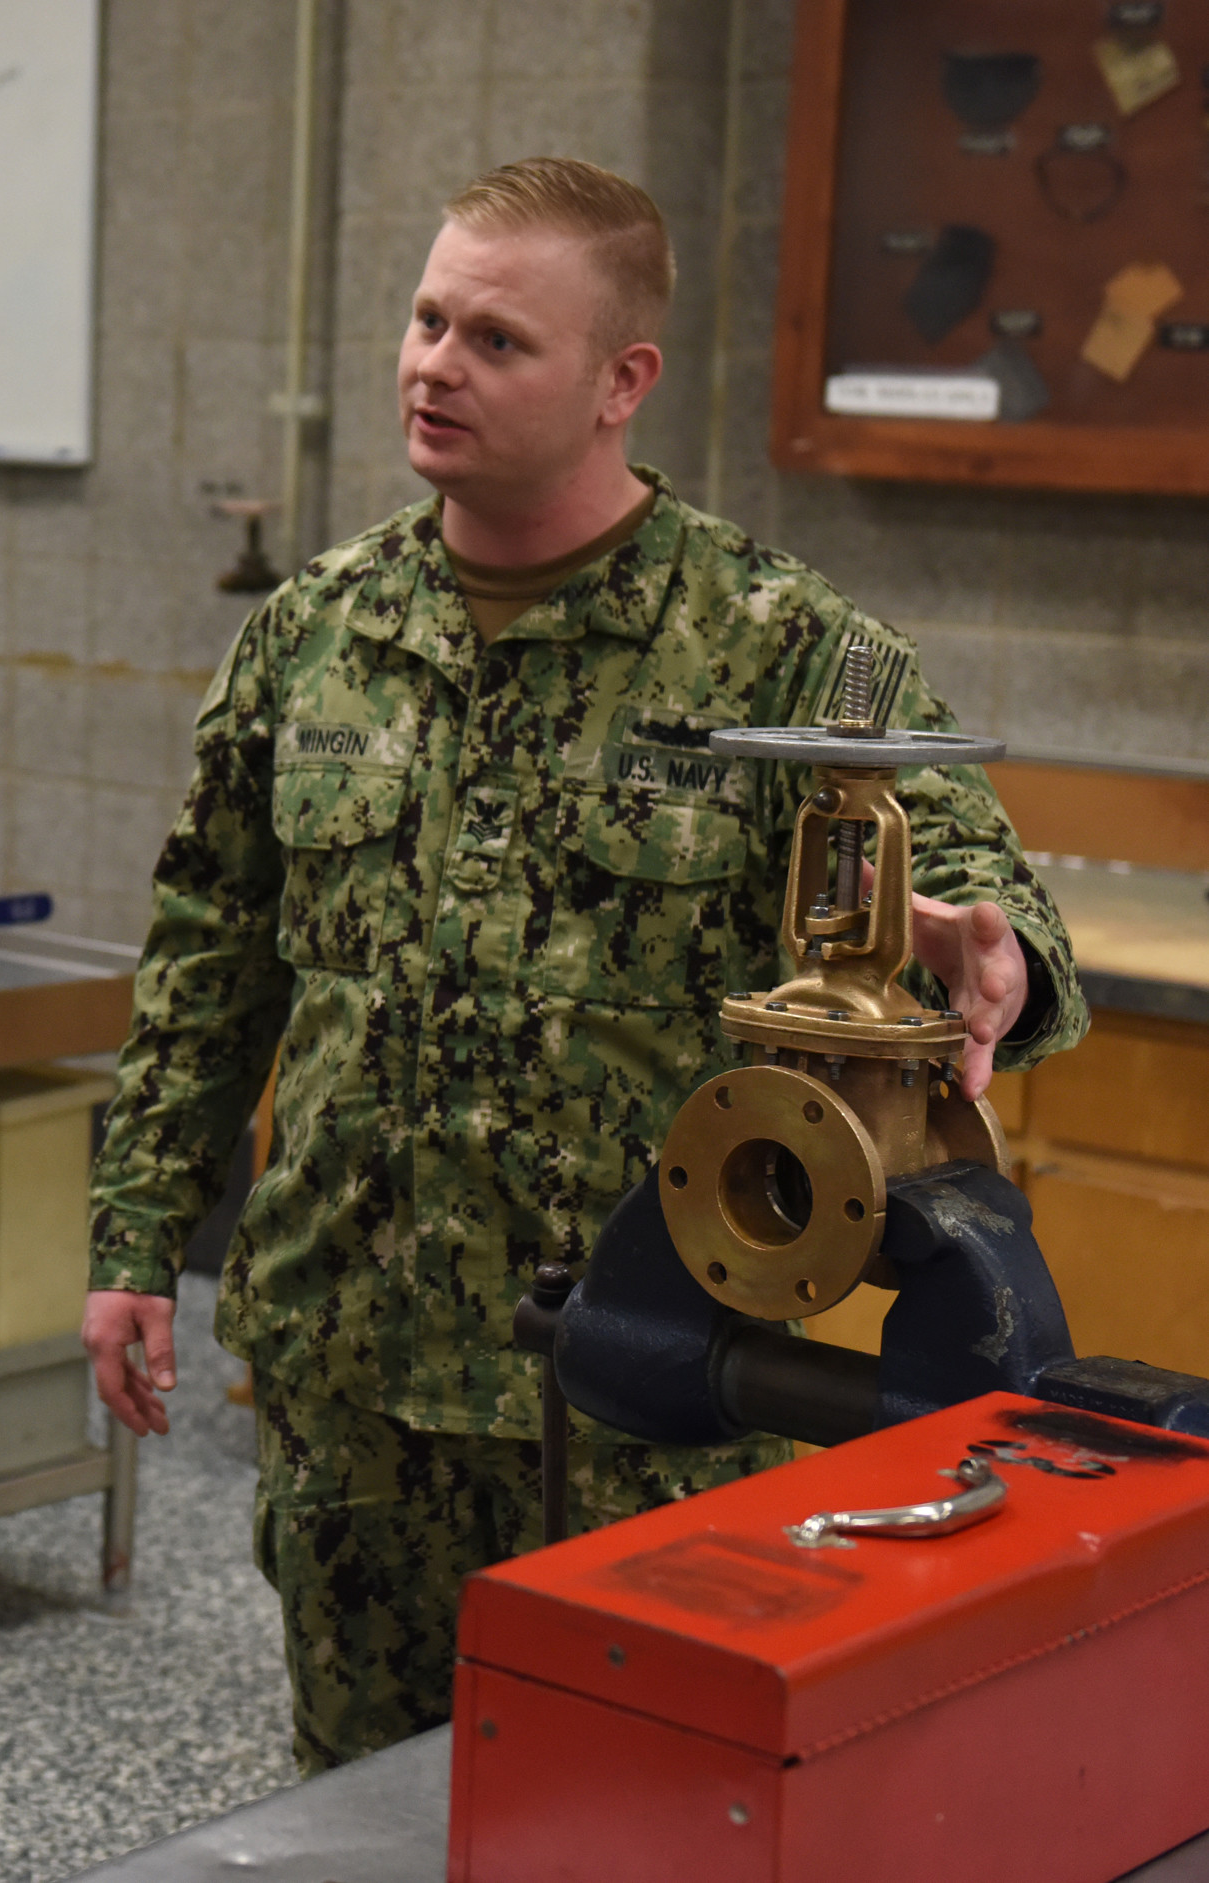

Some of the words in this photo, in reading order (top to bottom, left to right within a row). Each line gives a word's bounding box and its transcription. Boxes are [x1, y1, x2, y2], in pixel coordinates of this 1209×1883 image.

[299, 727, 369, 756] MINGIN
[618, 752, 656, 783] U.S.
[666, 758, 728, 793] NAVY
